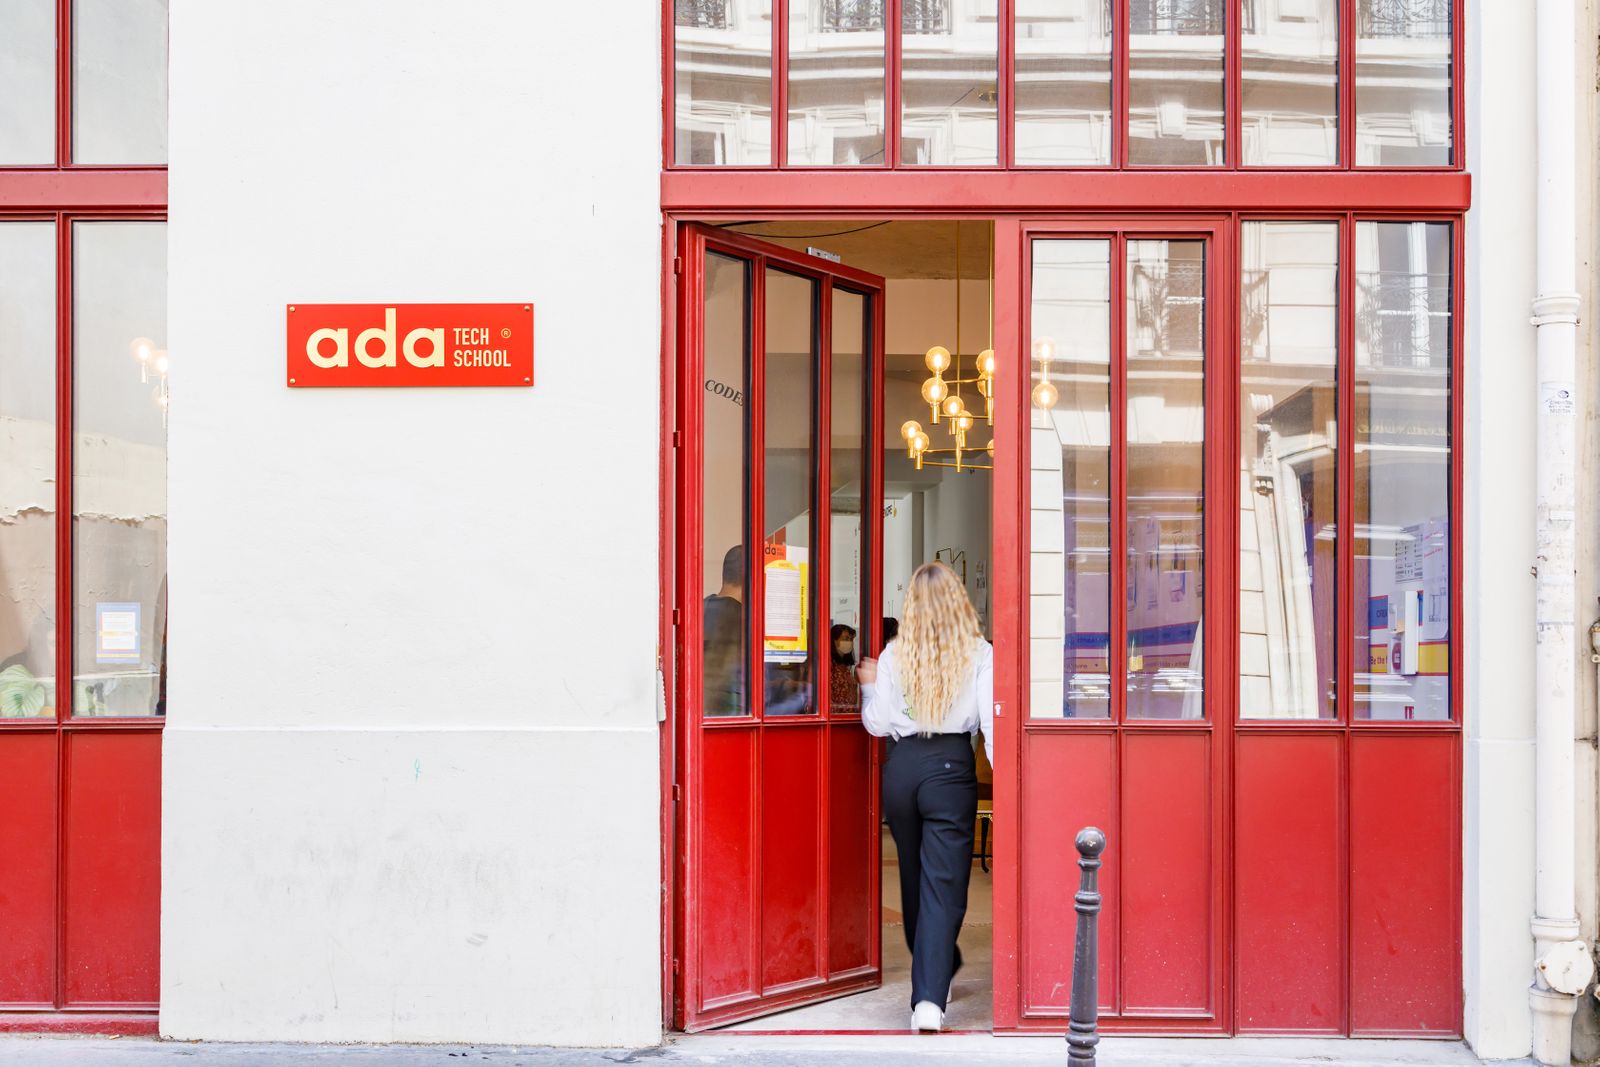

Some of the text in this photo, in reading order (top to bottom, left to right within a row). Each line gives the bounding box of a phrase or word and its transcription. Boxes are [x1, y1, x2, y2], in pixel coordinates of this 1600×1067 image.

[306, 308, 445, 368] ada
[453, 328, 489, 345] TECH
[453, 350, 511, 367] SCHOOL
